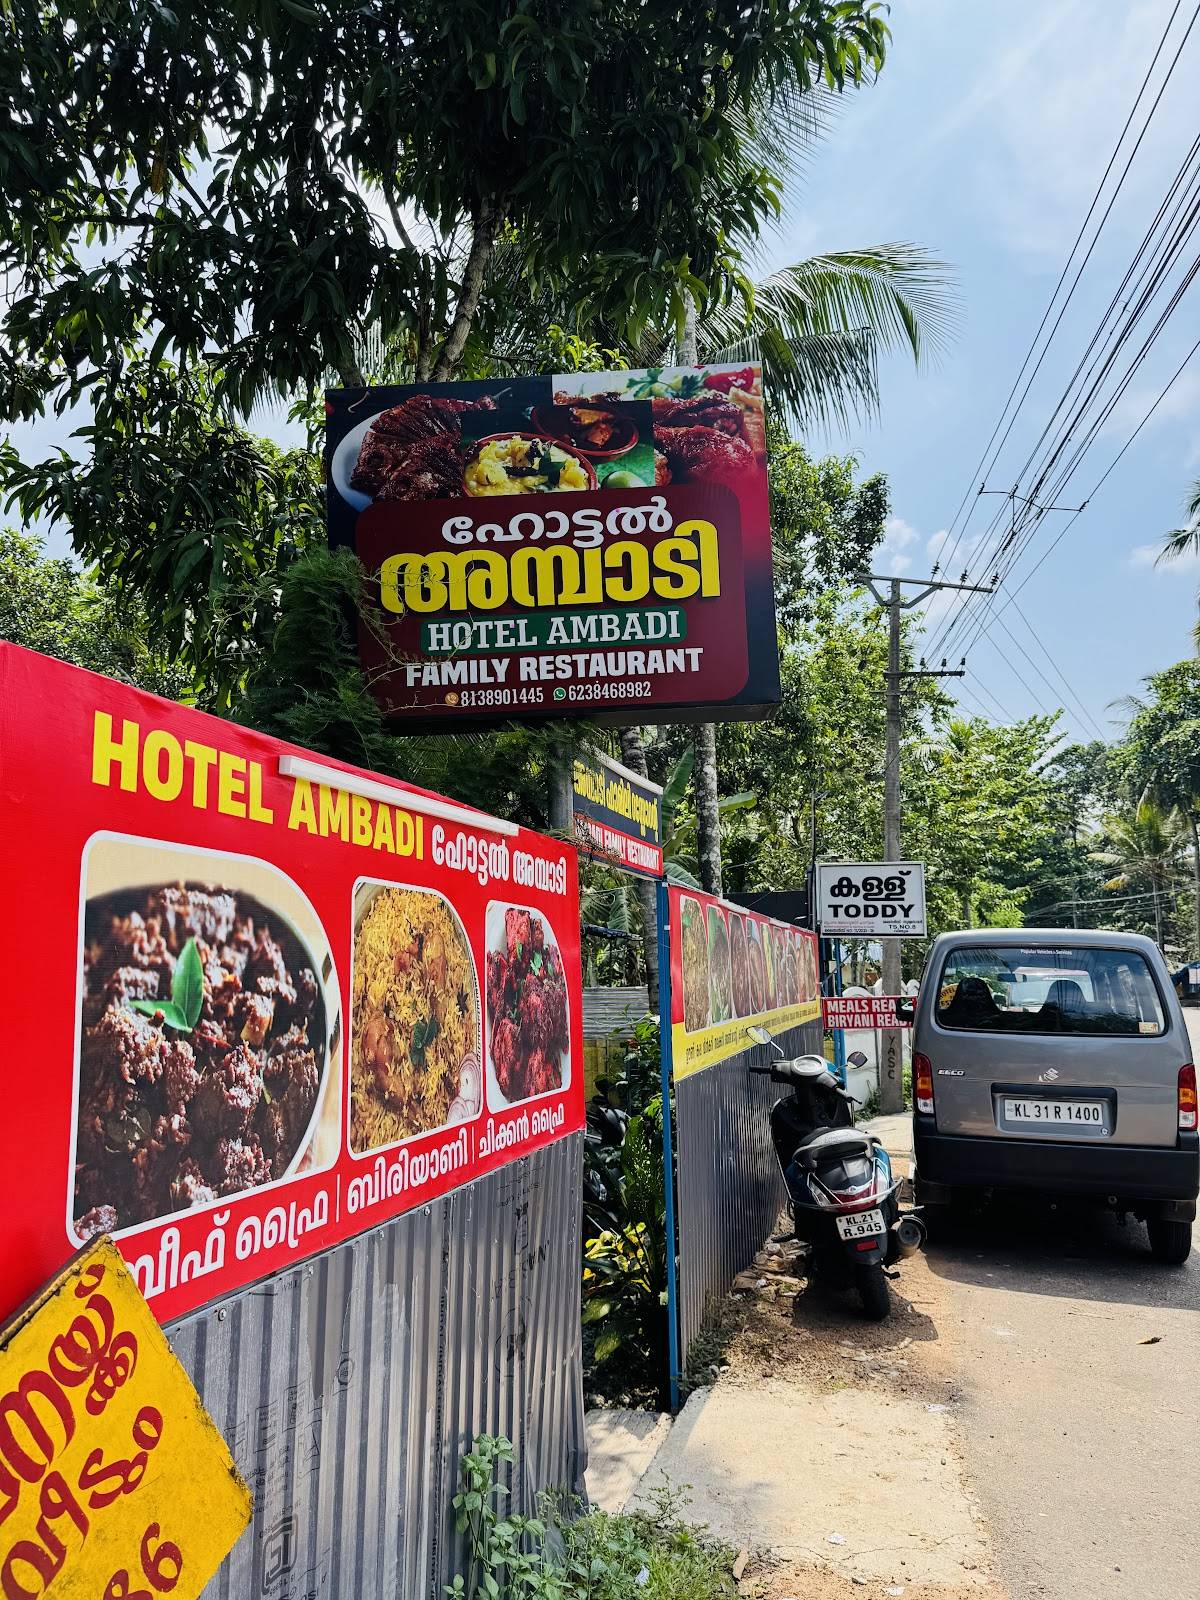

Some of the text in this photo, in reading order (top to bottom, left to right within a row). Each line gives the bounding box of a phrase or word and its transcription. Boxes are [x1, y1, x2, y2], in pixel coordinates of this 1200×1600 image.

[441, 496, 673, 548] ഹോട്ടൽ
[380, 520, 721, 614] അമ്പാടി
[427, 610, 681, 652] HOTEL AMBADI
[406, 648, 704, 687] FAMILY RESTAURANT
[460, 681, 652, 707] 8138901445 6238468982
[92, 710, 425, 861] HOTEL AMBADI
[431, 824, 567, 896] ഹോട്ടൽ അമ്പാടി
[829, 870, 912, 901] കള്ള്
[828, 904, 915, 918] TODDY
[826, 999, 869, 1013] MEALS
[828, 1014, 874, 1027] BIRYANI
[1015, 1103, 1031, 1118] KL
[1034, 1105, 1049, 1118] 31
[1054, 1106, 1061, 1119] R
[1067, 1106, 1100, 1121] 1400
[235, 1190, 328, 1260] ഫ്രൈ
[346, 1126, 469, 1214] ബിരിയാണി
[478, 1113, 530, 1159] ചിക്കൻ
[843, 1222, 882, 1238] R.945
